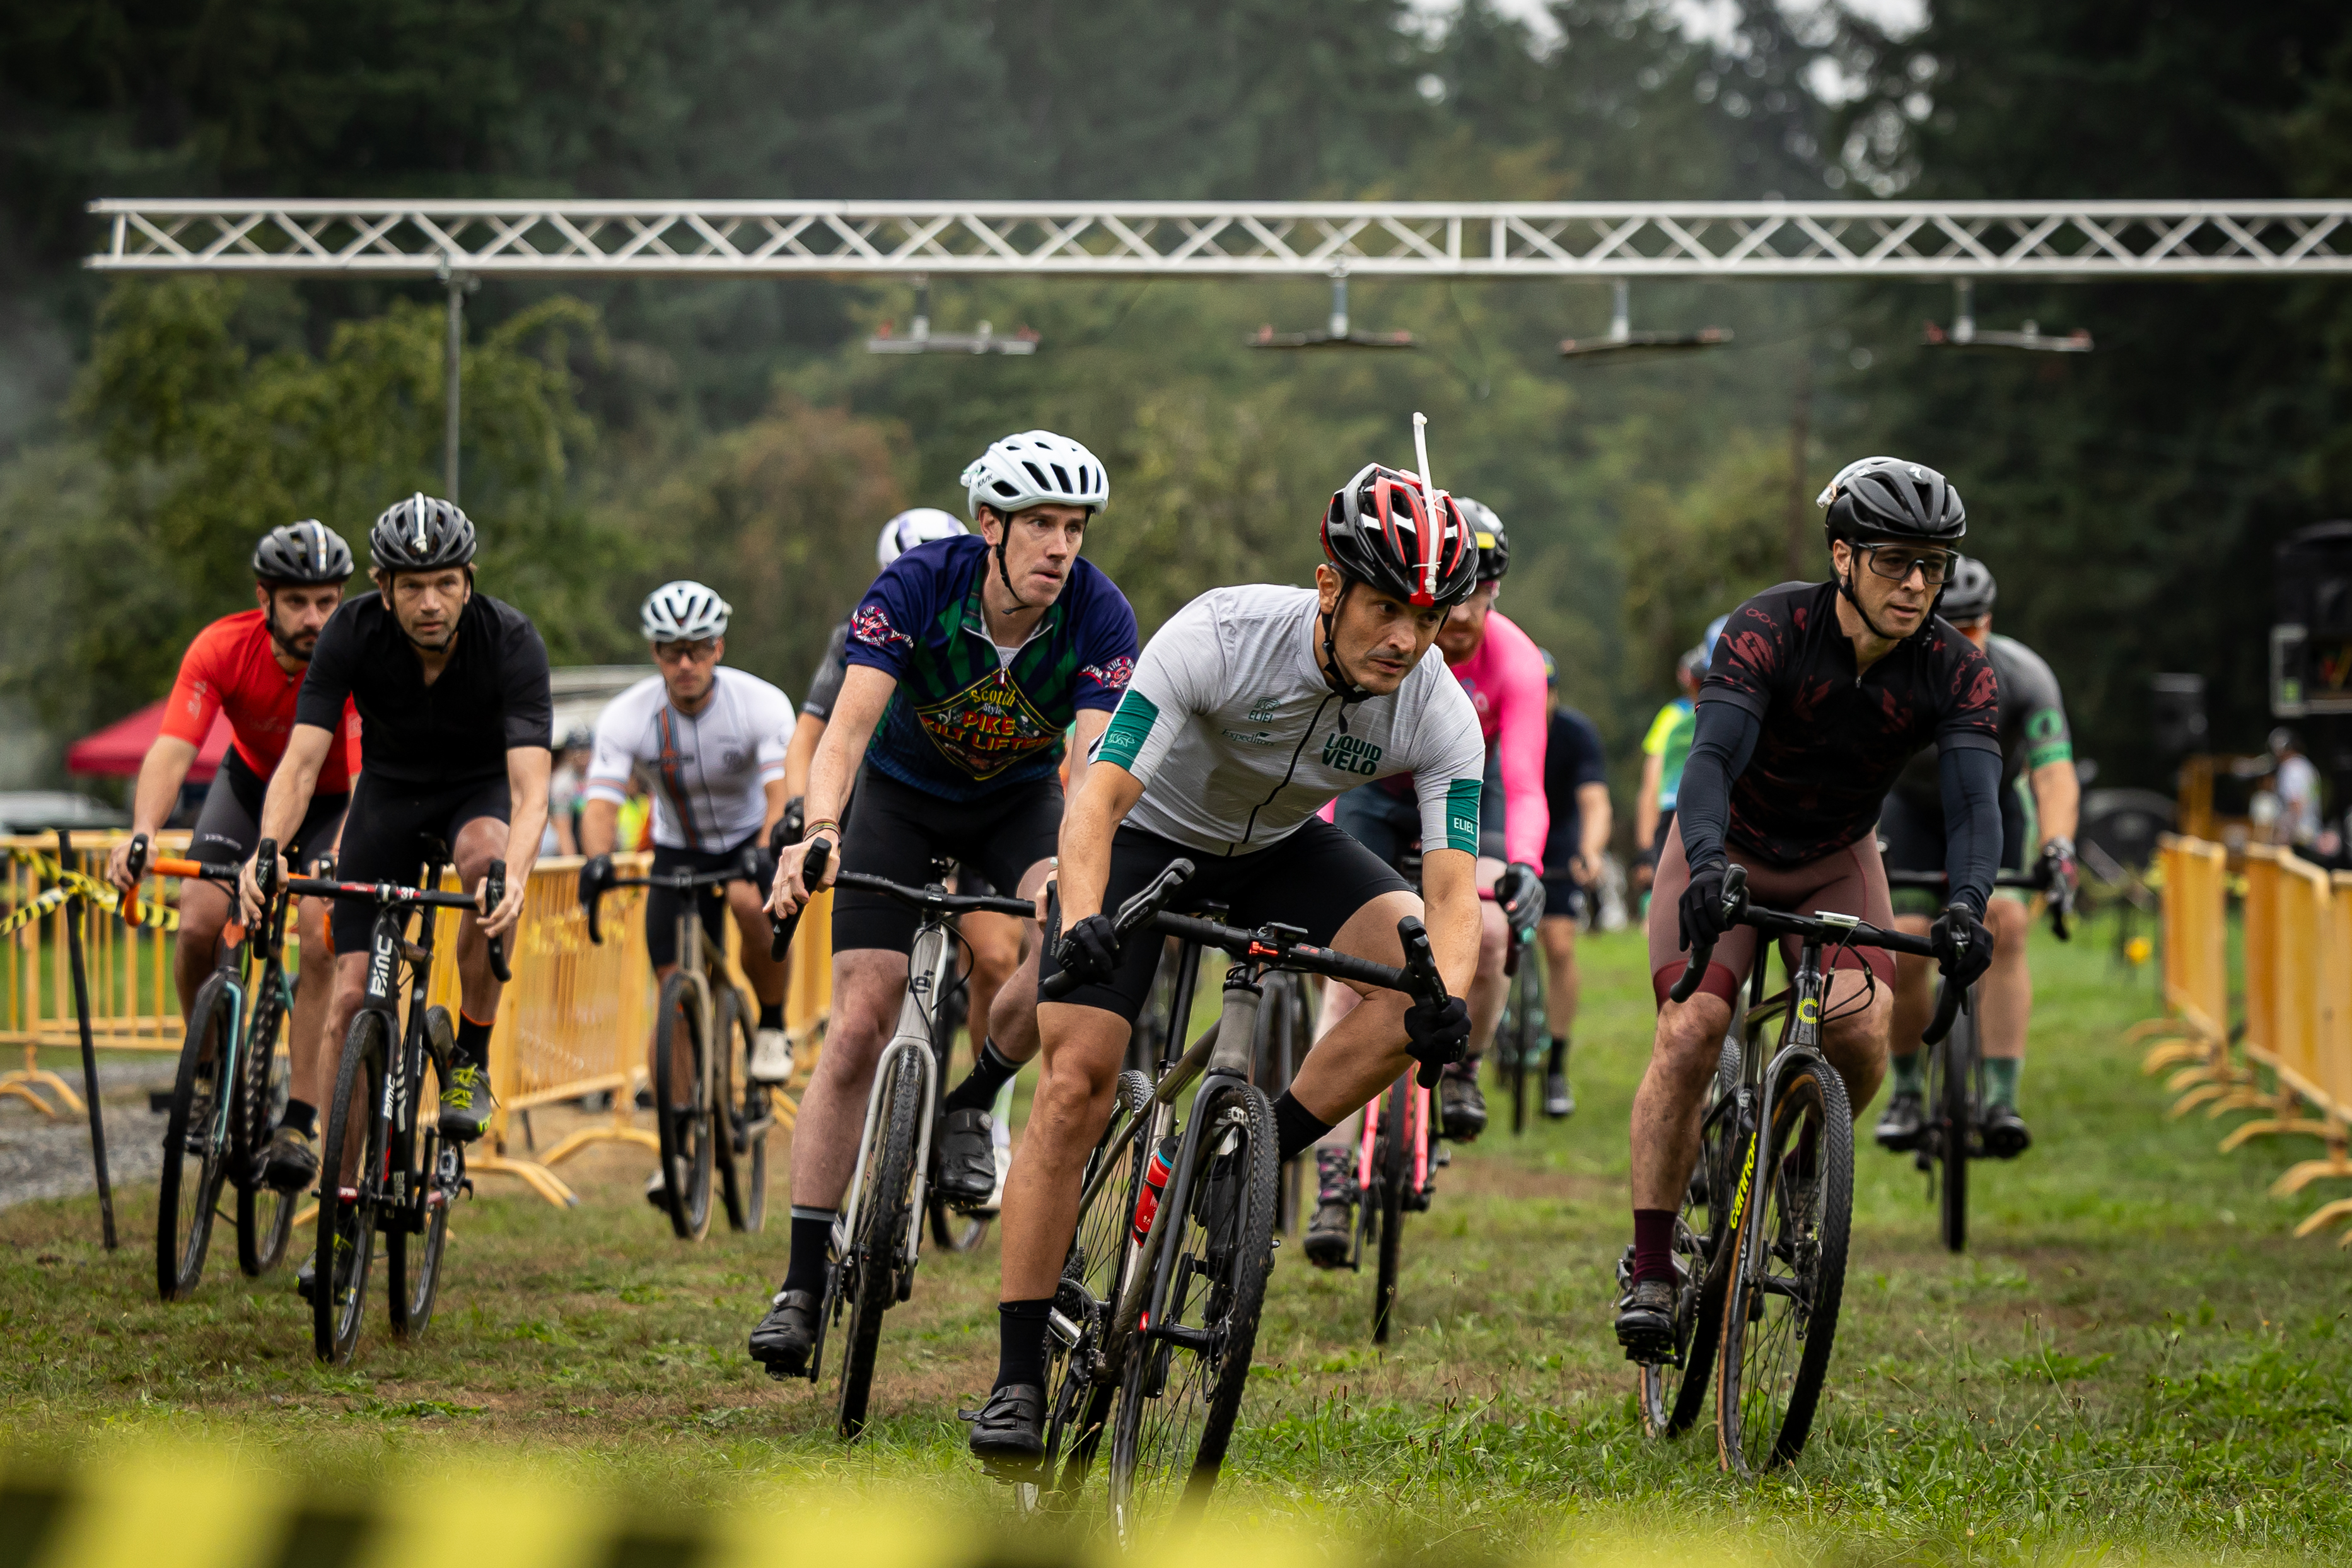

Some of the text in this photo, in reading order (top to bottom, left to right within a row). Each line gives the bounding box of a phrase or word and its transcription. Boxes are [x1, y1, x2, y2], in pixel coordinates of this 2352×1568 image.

[977, 473, 993, 488] KASK
[863, 607, 875, 617] THE
[1107, 658, 1122, 671] THE
[970, 689, 1016, 707] Scotch
[983, 703, 1003, 715] Style
[1248, 710, 1273, 724] ELIEL
[921, 716, 966, 741] KILT
[972, 732, 1052, 750] LIFTER
[962, 711, 1015, 736] PIKE
[1325, 733, 1383, 762] LIQUID
[1322, 748, 1378, 776] VELO
[1453, 817, 1475, 835] ELIEL
[1051, 931, 1059, 956] IZUMI
[370, 934, 393, 998] BMC
[383, 1072, 395, 1120] BMC
